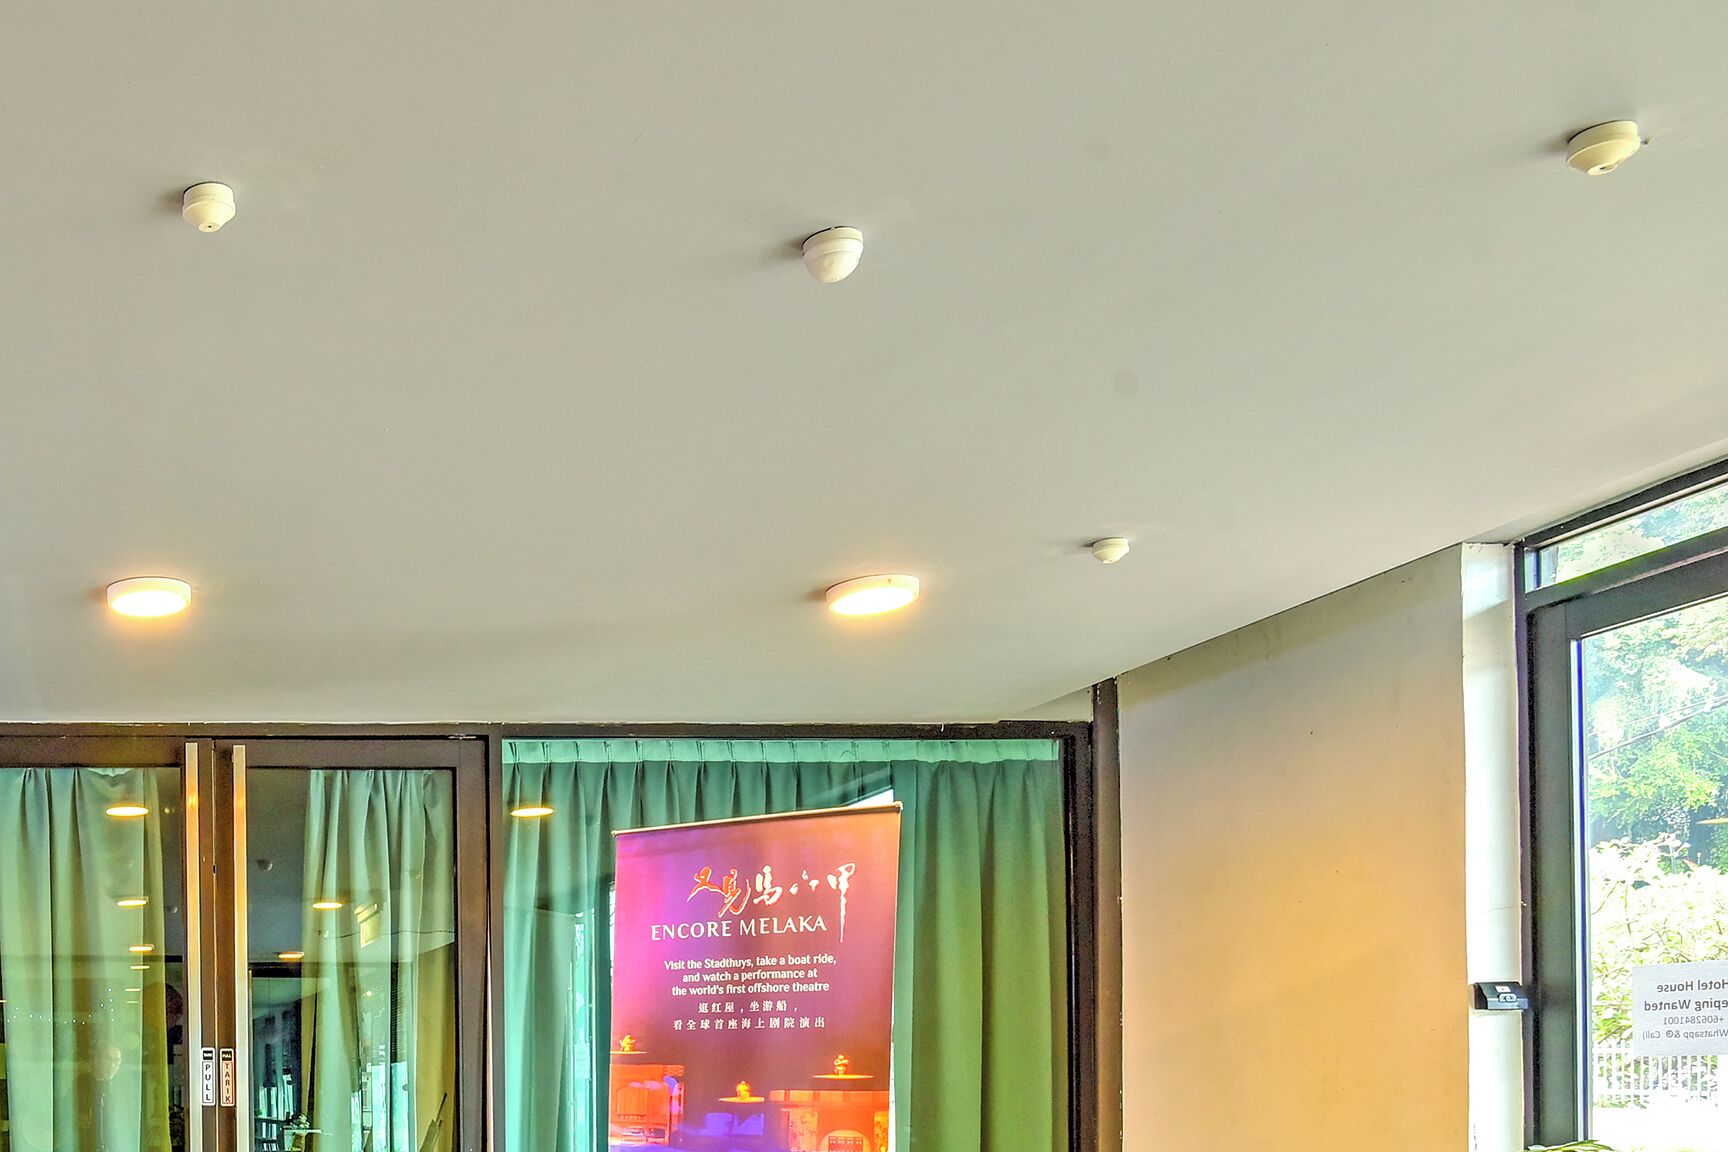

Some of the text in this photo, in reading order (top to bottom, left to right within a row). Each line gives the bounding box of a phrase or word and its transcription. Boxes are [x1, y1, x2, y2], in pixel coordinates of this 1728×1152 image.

[651, 915, 827, 941] ENCORE MELAKA
[664, 960, 685, 970] Visit
[687, 959, 702, 969] the
[704, 957, 754, 969] Stadthuys,
[756, 956, 777, 966] take
[788, 955, 811, 965] boat
[813, 954, 837, 965] ride,
[682, 972, 700, 982] and
[702, 971, 731, 981] watch
[741, 969, 805, 982] performance
[807, 968, 818, 978] at
[672, 982, 829, 996] the world's first offshore theatre
